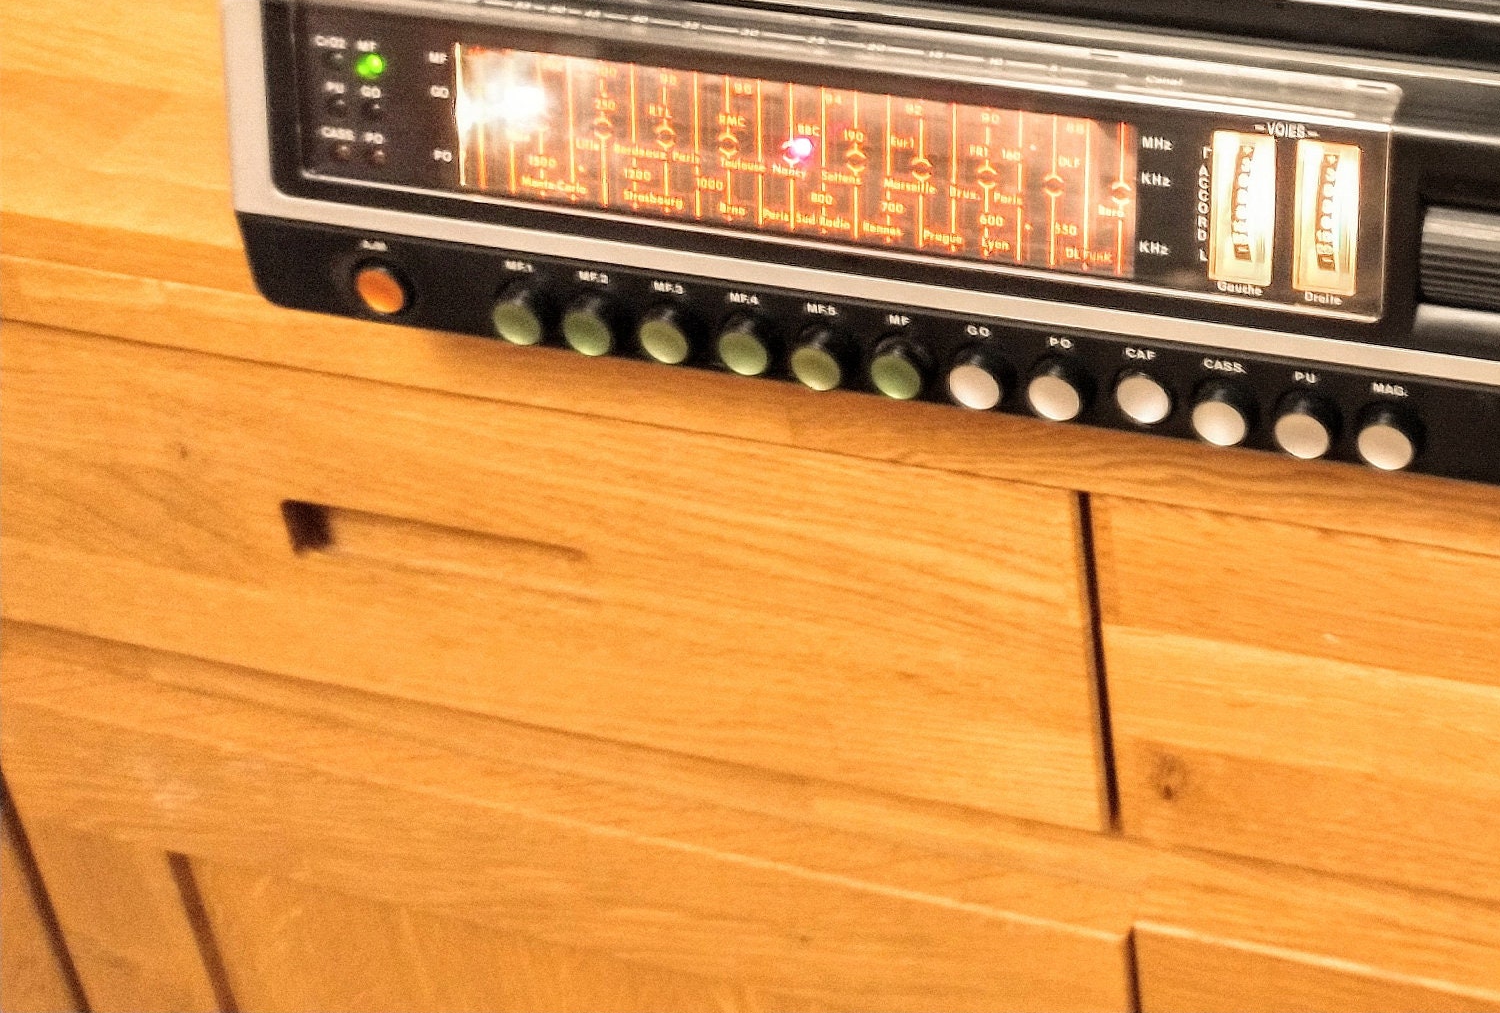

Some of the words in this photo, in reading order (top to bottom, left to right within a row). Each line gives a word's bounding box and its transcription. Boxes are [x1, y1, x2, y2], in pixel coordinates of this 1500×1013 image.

[360, 85, 381, 99] GO
[430, 84, 449, 99] GO
[1142, 135, 1173, 151] MHz
[1266, 121, 1307, 139] VOIES
[718, 113, 746, 128] RMC
[797, 123, 820, 137] BBC
[1141, 171, 1172, 187] KHz
[671, 149, 701, 165] Paris
[771, 162, 806, 180] Nancy
[883, 177, 938, 195] Marseille
[993, 191, 1023, 207] Paris
[433, 148, 453, 163] PO
[695, 177, 724, 191] 1000
[881, 201, 905, 214] 700
[979, 213, 1004, 227] 600
[1139, 239, 1170, 256] KHz
[623, 188, 684, 211] Strasbourg
[818, 214, 851, 230] Radio
[981, 235, 1010, 251] Lyon
[1215, 281, 1264, 297] Gauche
[888, 313, 912, 327] MF
[966, 324, 992, 338] GO
[1049, 336, 1074, 350] PO
[1124, 347, 1157, 361] CAF
[1294, 370, 1319, 384] PU
